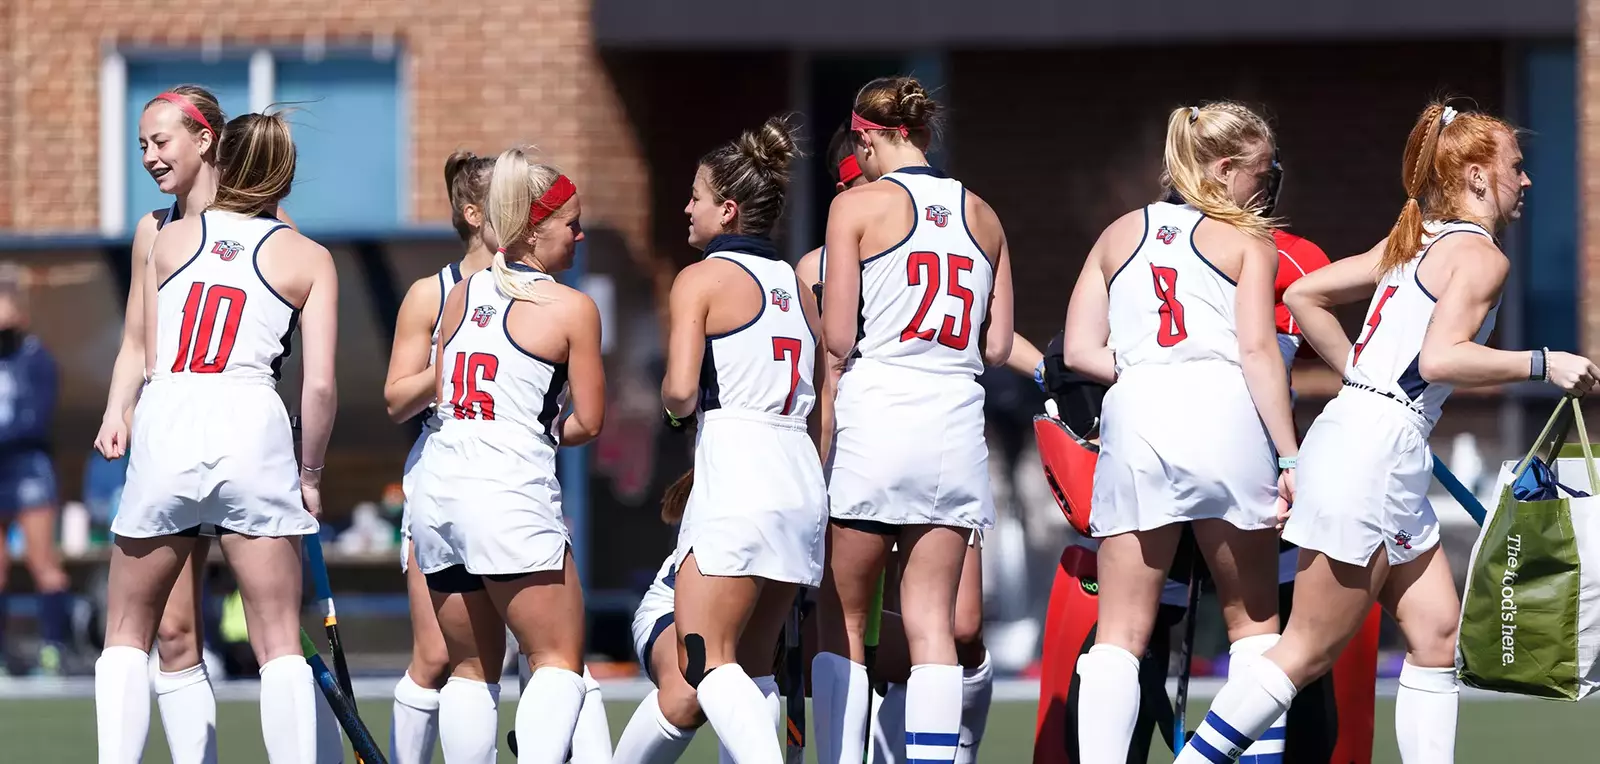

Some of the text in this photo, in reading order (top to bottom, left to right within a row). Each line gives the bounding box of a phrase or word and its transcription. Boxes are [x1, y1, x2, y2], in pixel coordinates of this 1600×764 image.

[171, 281, 247, 373] 10
[900, 251, 974, 351] 25
[1149, 262, 1188, 347] 8
[450, 352, 499, 420] 16
[771, 336, 801, 415] 7
[1501, 534, 1520, 666] The food's here.
